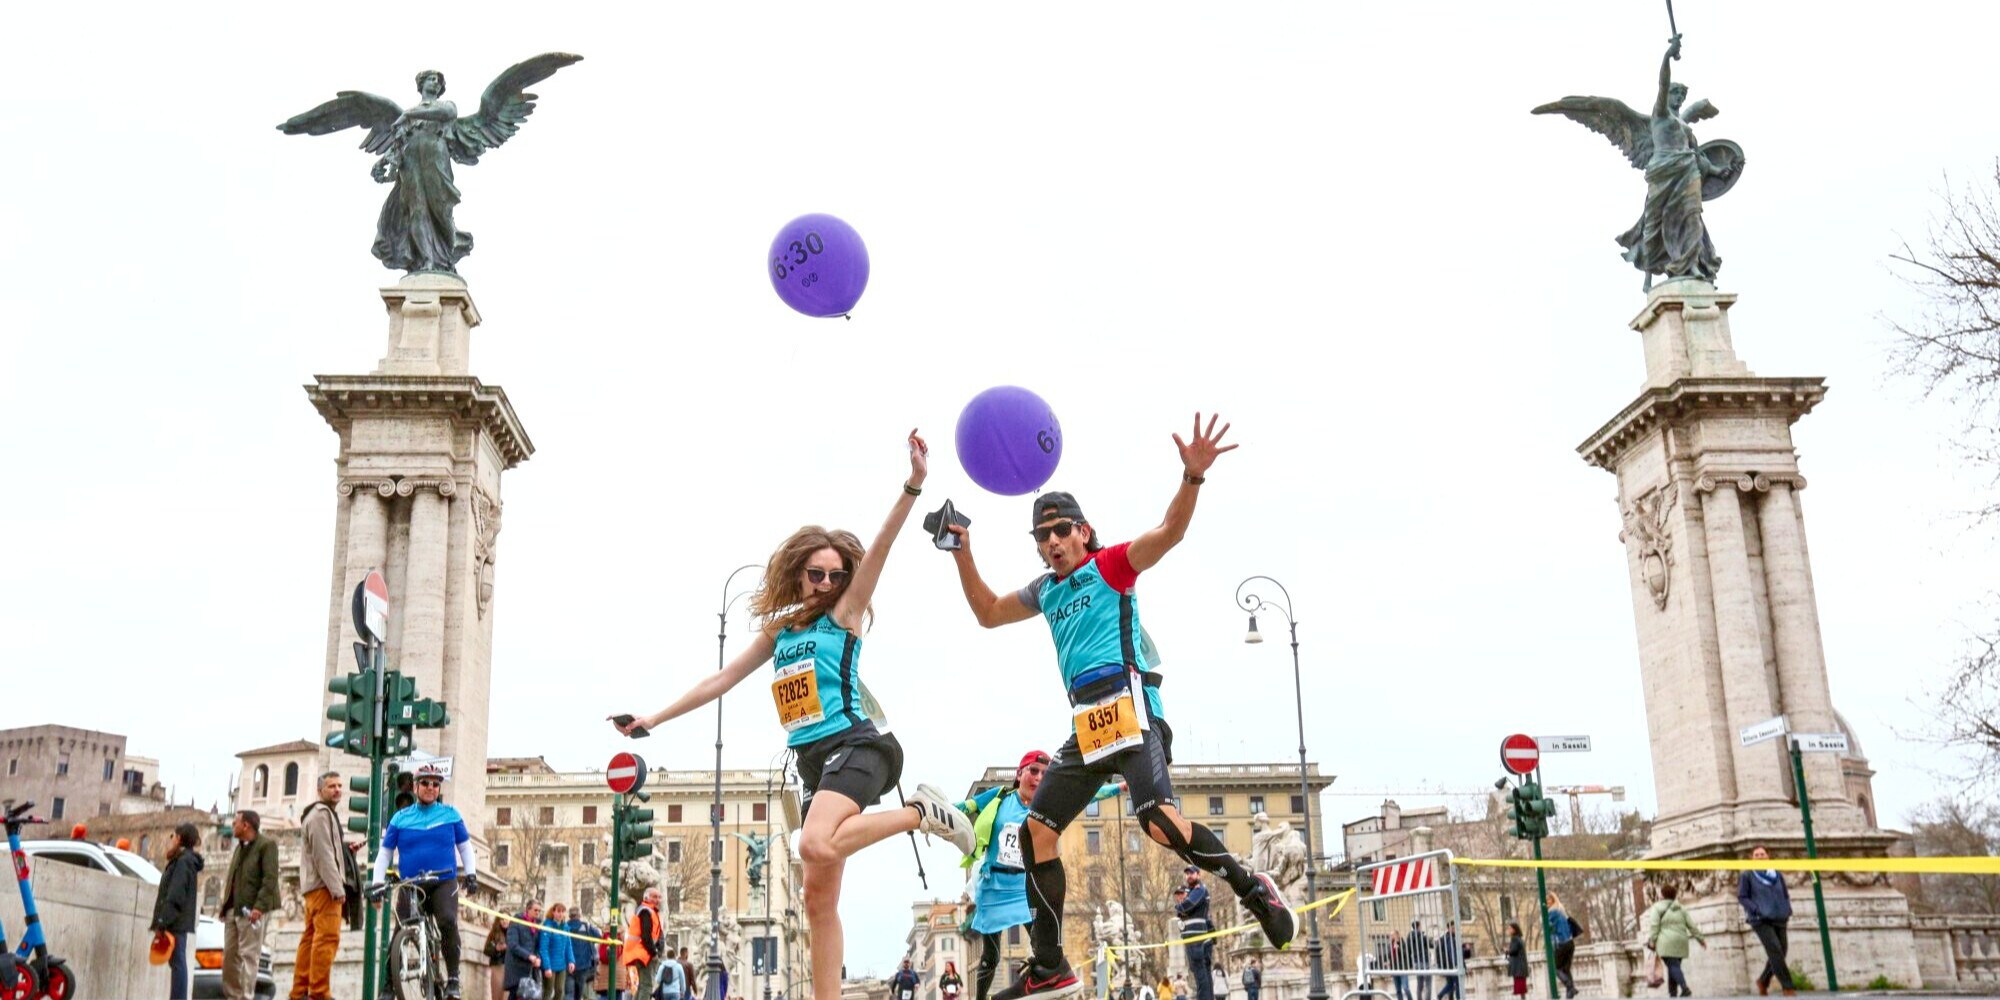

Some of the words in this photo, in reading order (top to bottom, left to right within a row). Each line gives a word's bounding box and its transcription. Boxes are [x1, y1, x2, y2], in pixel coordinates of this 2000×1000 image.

[773, 232, 824, 280] 6:30
[778, 677, 809, 705] F2825
[800, 706, 807, 717] A
[1088, 702, 1119, 731] 8357
[1093, 739, 1102, 749] 12
[1115, 730, 1123, 740] A
[1552, 742, 1560, 750] In
[1563, 742, 1587, 750] Sassia
[1808, 741, 1817, 749] In
[1820, 741, 1845, 749] Sassia
[1005, 833, 1020, 849] F2
